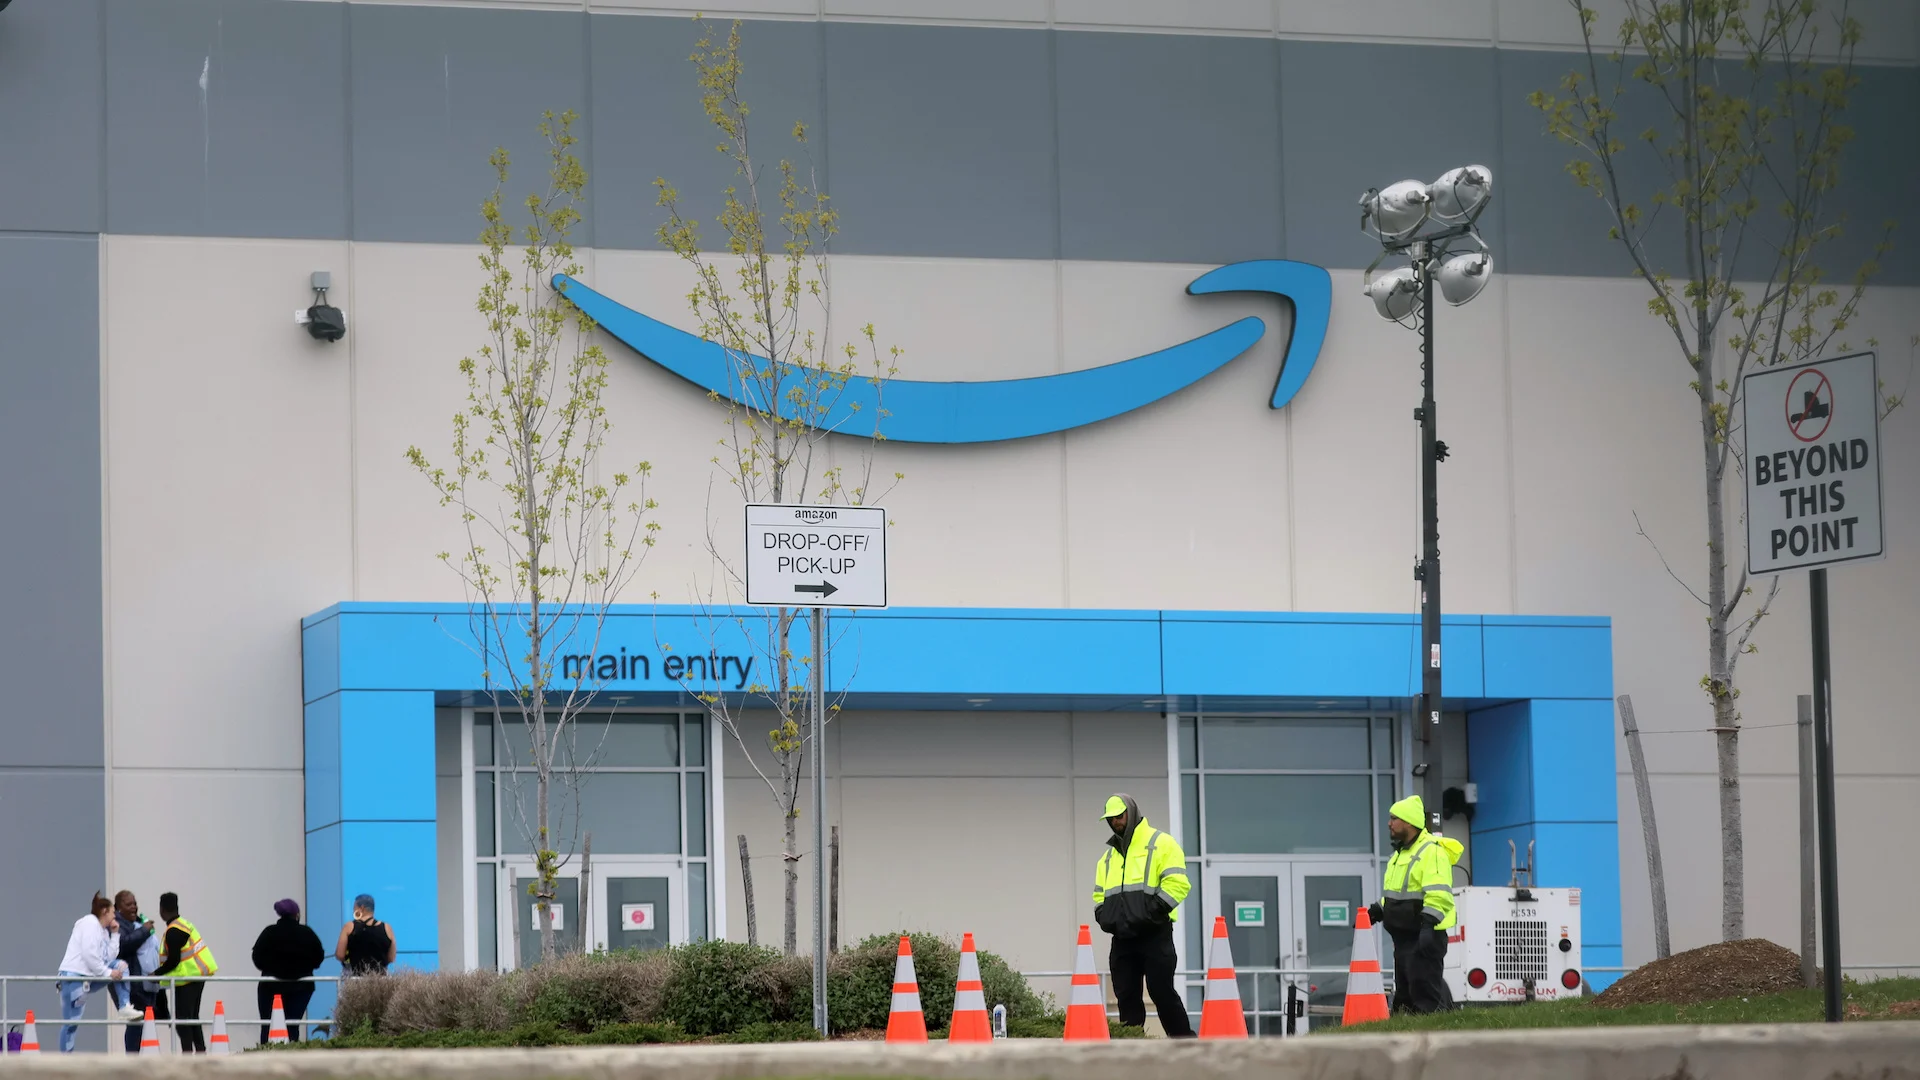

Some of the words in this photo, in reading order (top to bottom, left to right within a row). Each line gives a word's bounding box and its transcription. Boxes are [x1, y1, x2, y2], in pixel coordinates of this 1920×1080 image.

[1755, 438, 1869, 486] BEYOND
[794, 509, 837, 519] amazon
[1780, 480, 1845, 519] THIS
[763, 532, 869, 551] DROP-OFF/
[1771, 516, 1859, 560] POINT
[778, 556, 856, 575] PICK-UP
[563, 646, 649, 680] main
[663, 648, 753, 689] entry
[1490, 984, 1556, 996] MAGUM
